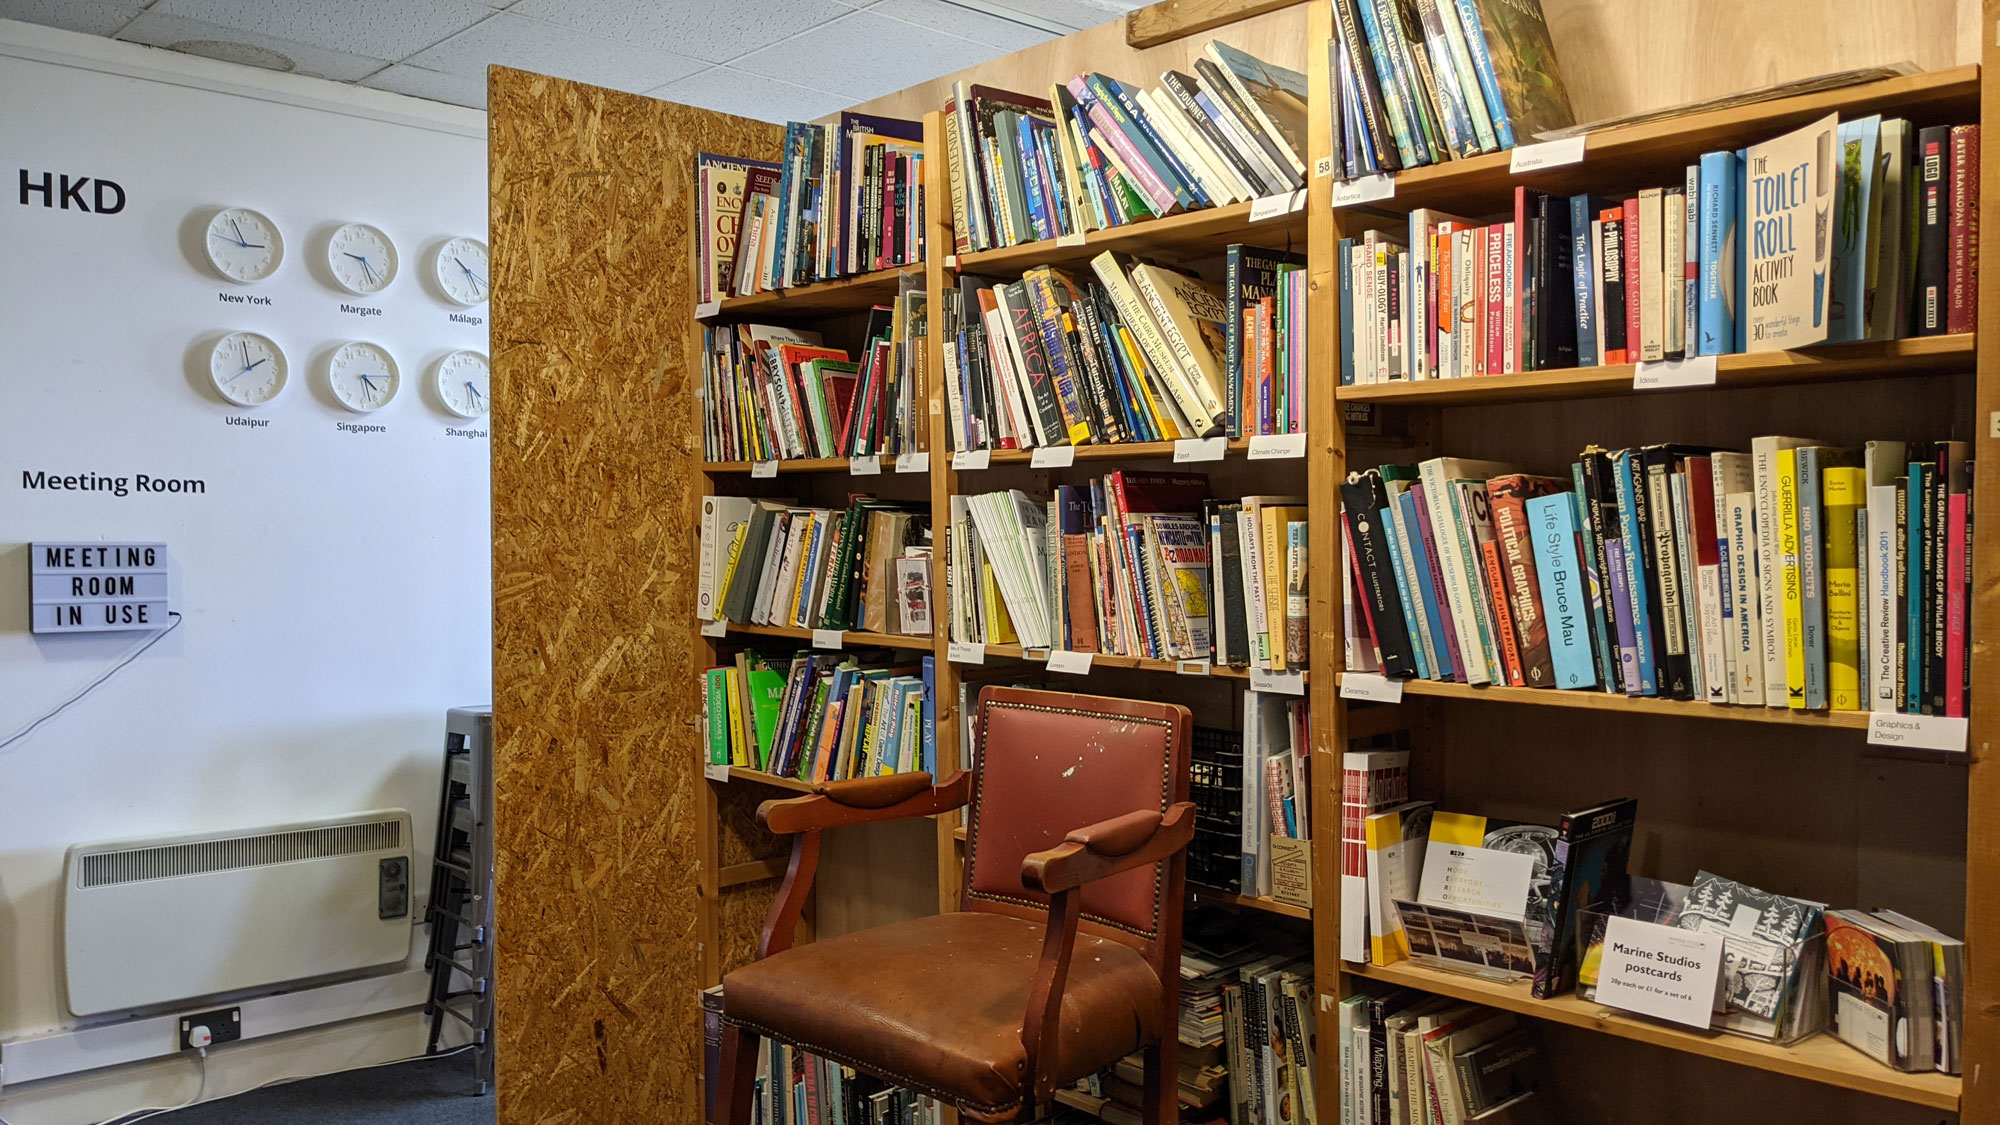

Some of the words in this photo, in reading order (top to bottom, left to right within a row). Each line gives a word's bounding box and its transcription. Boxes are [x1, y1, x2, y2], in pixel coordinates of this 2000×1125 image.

[1118, 94, 1138, 120] PSA
[1167, 74, 1181, 92] THE
[1178, 92, 1207, 123] JOURNEY
[853, 126, 873, 134] BRITISH
[1516, 158, 1542, 168] Australia
[1753, 156, 1768, 176] THE
[1956, 139, 1965, 166] PETER
[755, 174, 778, 184] SEEDS
[1318, 161, 1330, 172] 58
[1926, 157, 1938, 179] LOGO
[19, 168, 126, 215] HKD
[1112, 176, 1129, 209] MALAY
[1337, 192, 1361, 201] Antartica
[1711, 185, 1719, 218] RICHARD
[1753, 163, 1809, 217] TOILET
[1956, 169, 1964, 227] FRANKOPAN
[953, 187, 966, 228] SOVIET
[1254, 208, 1277, 217] Singapore
[750, 218, 760, 248] China
[1576, 234, 1584, 253] The
[1630, 214, 1638, 261] STEPHEN
[1754, 213, 1796, 259] ROLL
[1490, 233, 1501, 302] PRICELESS
[1576, 255, 1585, 280] Logic
[1604, 231, 1619, 282] PHILOSOPHY
[1753, 256, 1794, 284] ACTIVITY
[1463, 260, 1471, 295] Obliquity
[1577, 282, 1585, 290] of
[1631, 268, 1639, 285] JAY
[219, 292, 242, 303] New
[245, 294, 272, 306] York
[1753, 284, 1778, 307] BOOK
[340, 304, 382, 317] Margate
[449, 312, 483, 326] Málaga
[1579, 292, 1588, 329] Practice
[1632, 291, 1640, 329] GOULD
[1129, 298, 1141, 315] THE
[1137, 316, 1151, 339] CAIRO
[1151, 340, 1174, 373] MUSEUM
[1229, 324, 1234, 334] OF
[1753, 324, 1765, 340] 30
[1012, 308, 1045, 389] AFRICA
[1167, 330, 1191, 360] EGYPT
[770, 358, 784, 399] BRYSON
[1640, 376, 1659, 384] Ideas
[225, 416, 269, 429] Udaipur
[336, 421, 386, 434] Singapore
[446, 427, 487, 439] Shanghai
[1758, 453, 1767, 473] THE
[1801, 450, 1809, 484] BEWICK
[22, 470, 128, 497] Meeting
[136, 474, 206, 493] Room
[1759, 475, 1770, 547] ENCYCLOPEDIA
[1781, 476, 1793, 530] GUERRILLA
[1544, 504, 1560, 530] Life
[1734, 507, 1745, 551] GRAPHIC
[1803, 506, 1811, 530] 1800
[1247, 517, 1255, 550] HOLIDAYS
[1620, 515, 1631, 551] Poster
[1880, 531, 1888, 551] 2011
[46, 549, 156, 567] MEETING
[826, 544, 837, 579] FERNS
[1267, 524, 1276, 572] DESIGNING
[1547, 533, 1565, 567] Style
[1763, 549, 1771, 563] OF
[1497, 507, 1520, 564] POLITICAL
[1512, 566, 1536, 621] GRAPHICS
[1656, 531, 1676, 604] Propaganda
[1736, 555, 1747, 591] DESIGN
[1764, 564, 1772, 591] SIGNS
[1784, 534, 1797, 600] ADVERTISING
[1804, 535, 1815, 598] WOODCUTS
[1879, 552, 1889, 596] Handbook
[72, 577, 134, 595] ROOM
[1268, 575, 1277, 586] THE
[1371, 572, 1385, 612] ILLUSTRATORS
[1554, 571, 1571, 612] Bruce
[1624, 552, 1641, 625] Renaissance
[1829, 580, 1851, 589] Mario
[1829, 589, 1851, 597] Bellini
[1268, 588, 1279, 612] SEASIDE
[1739, 594, 1747, 604] IN
[1765, 594, 1773, 615] AND
[1881, 598, 1889, 627] Review
[57, 607, 82, 625] IN
[106, 605, 149, 623] USE
[1561, 616, 1575, 646] Mau
[1740, 607, 1750, 652] AMERICA
[1766, 618, 1775, 662] SYMBOLS
[1636, 631, 1646, 663] MARGOLIN
[1880, 629, 1890, 663] Creative
[1881, 665, 1890, 680] The
[1345, 687, 1369, 696] Ceramics
[1874, 732, 1904, 741] Design
[1876, 719, 1912, 730] Graphics
[1913, 721, 1920, 730] &
[862, 724, 872, 753] REPLAY
[1613, 942, 1653, 959] Marine
[1657, 952, 1701, 969] Studios
[1611, 978, 1621, 986] 20p
[1625, 963, 1682, 981] postcards
[1373, 1047, 1384, 1087] Mapping
[1408, 1046, 1416, 1085] MAPPING
